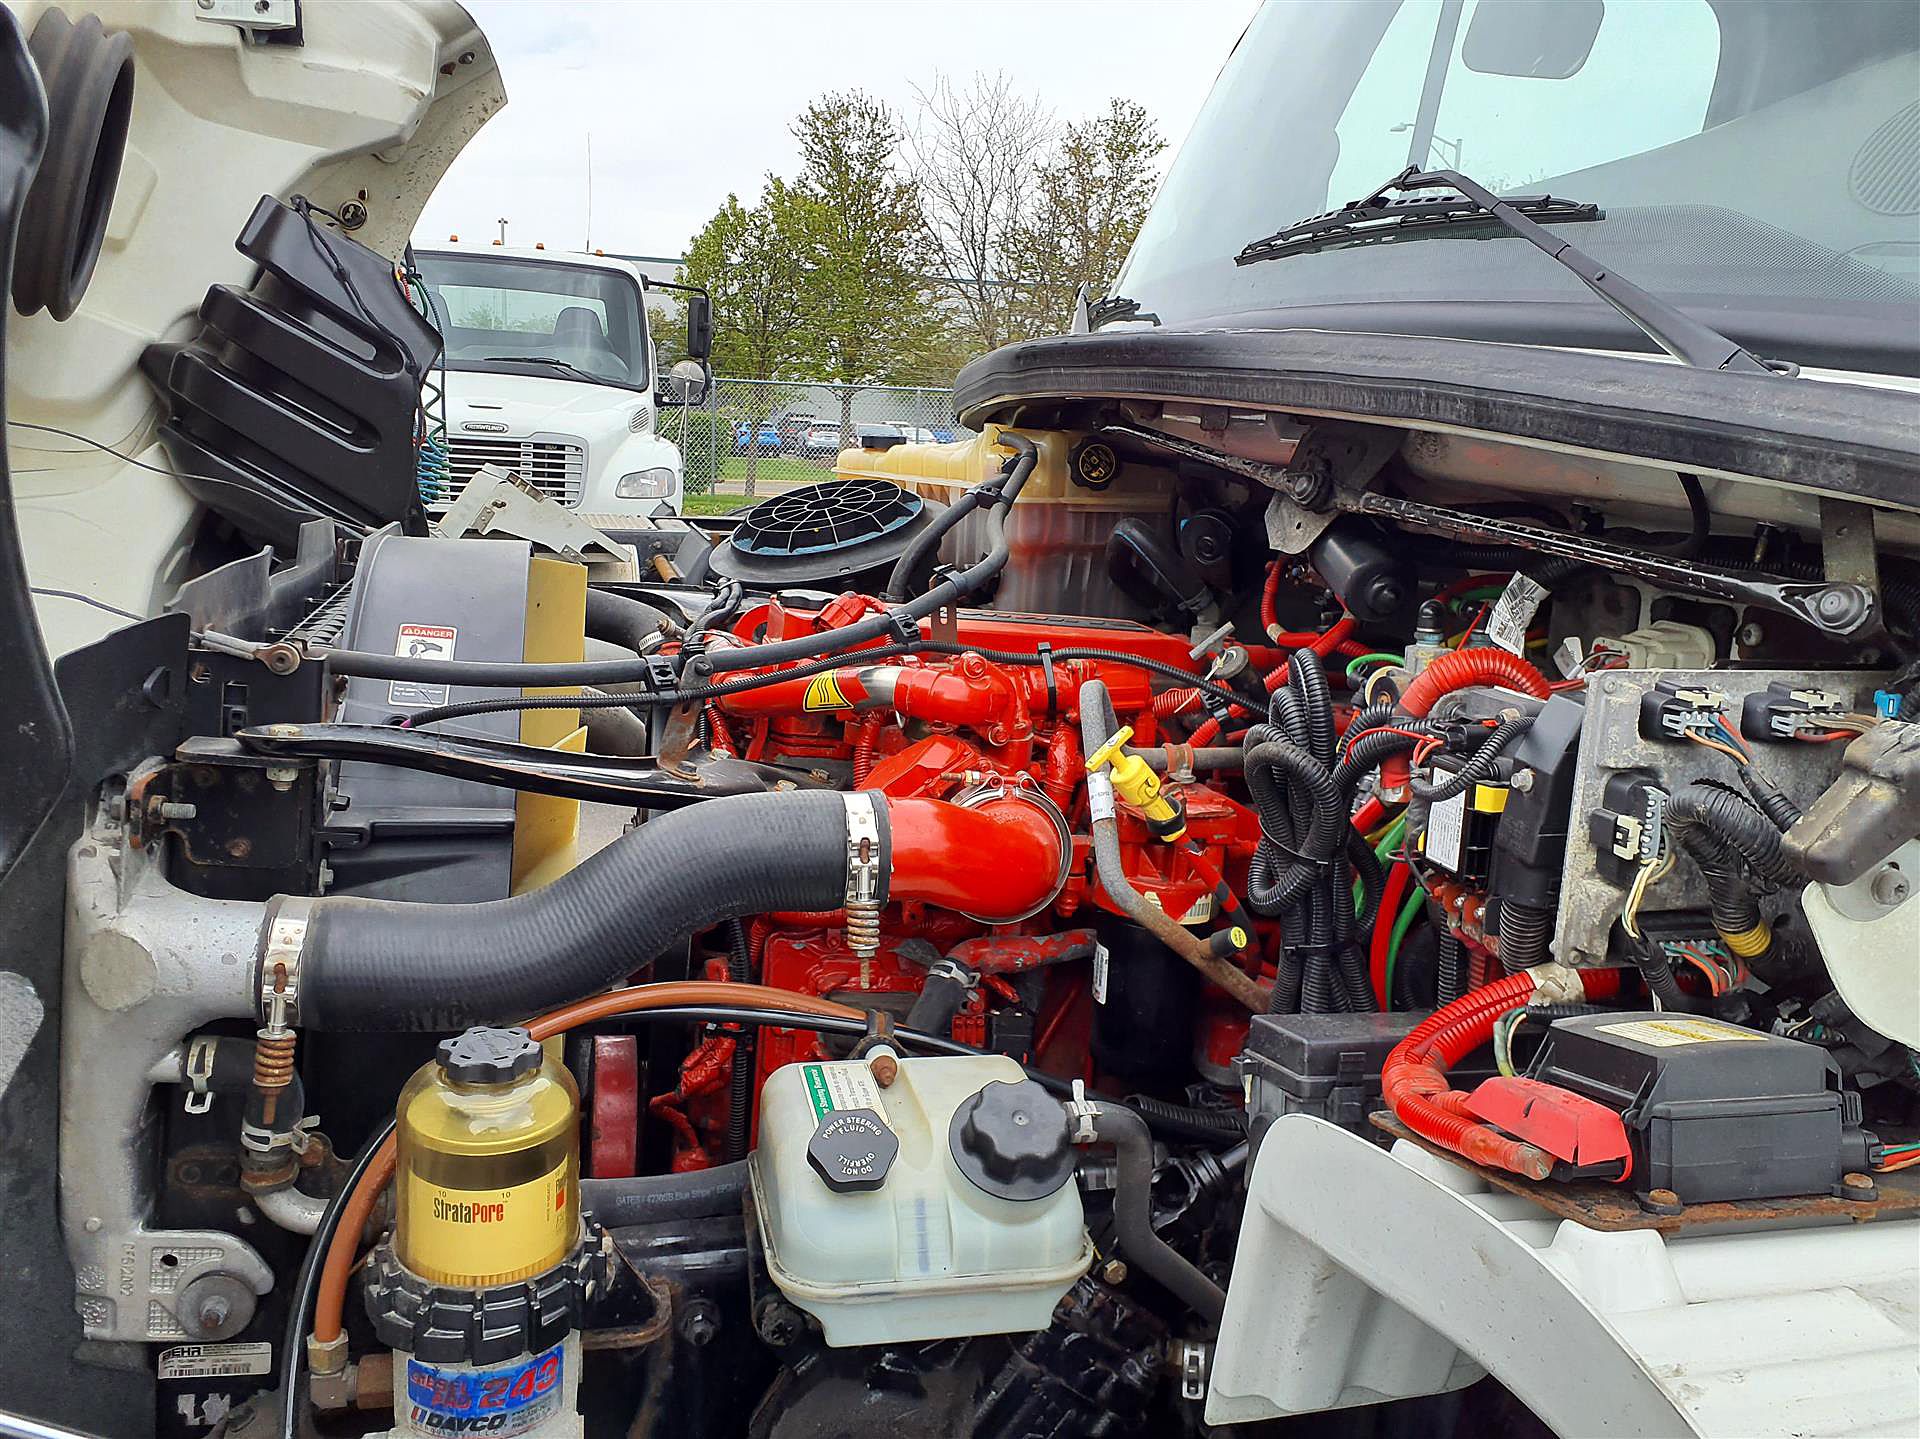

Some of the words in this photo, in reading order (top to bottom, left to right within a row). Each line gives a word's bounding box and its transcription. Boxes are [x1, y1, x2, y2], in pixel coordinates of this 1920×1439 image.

[414, 628, 453, 638] DANGER
[822, 1117, 845, 1140] POWER
[846, 1116, 882, 1136] STEERING
[838, 1124, 865, 1135] FLUID
[838, 1152, 875, 1168] OVERFILL
[841, 1166, 859, 1176] NOT
[861, 1165, 873, 1175] DO
[501, 1191, 511, 1199] 10
[433, 1197, 504, 1224] StrataPore
[478, 1355, 560, 1410] 243
